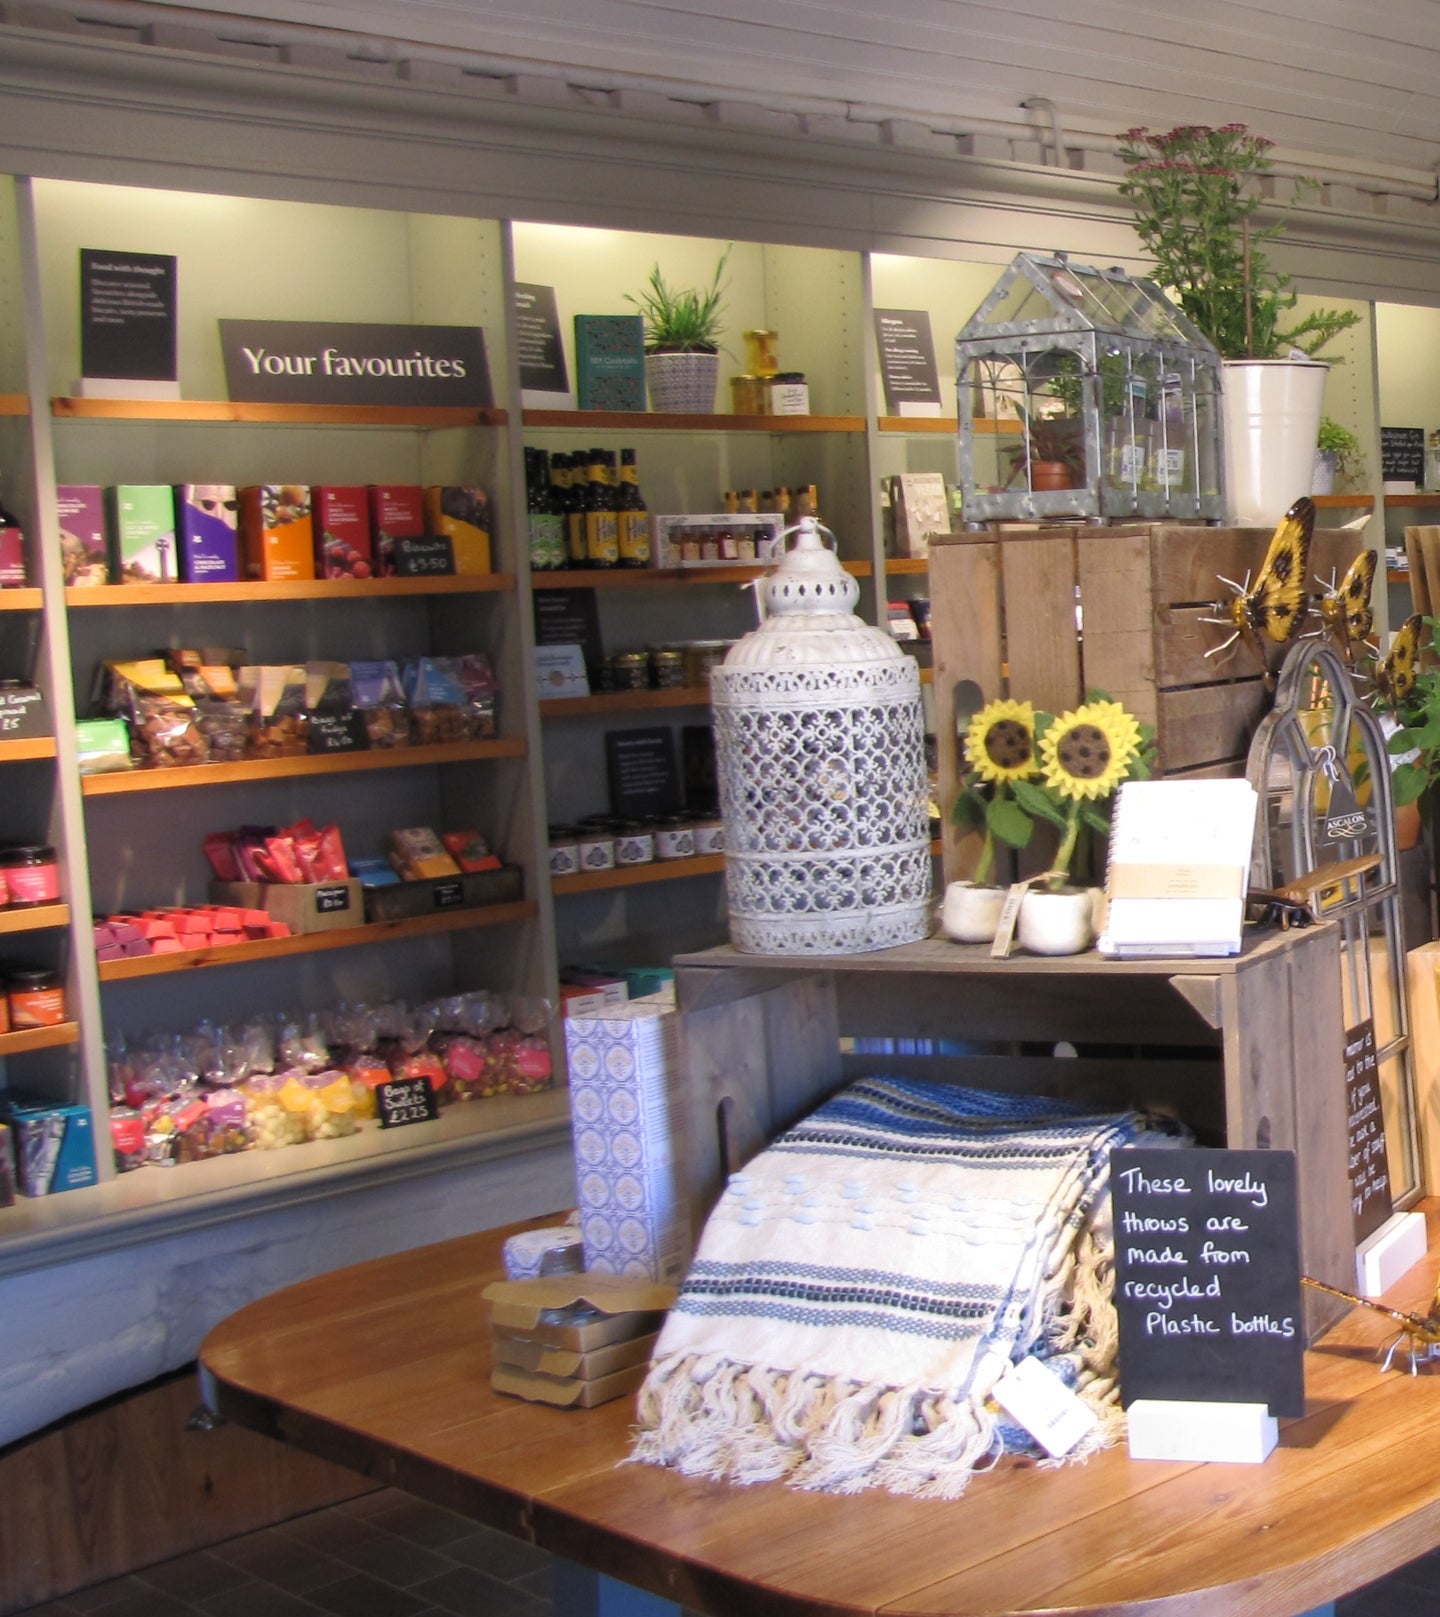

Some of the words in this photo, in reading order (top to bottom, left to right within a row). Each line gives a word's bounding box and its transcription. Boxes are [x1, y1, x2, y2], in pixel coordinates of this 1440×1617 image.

[242, 347, 317, 375] Your
[322, 348, 467, 378] favourites
[1327, 815, 1365, 830] ASCALON
[384, 1085, 410, 1100] Bags
[412, 1080, 425, 1092] of
[385, 1094, 427, 1109] Sweets
[1120, 1167, 1192, 1194] These
[1208, 1169, 1268, 1206] lovely
[1122, 1211, 1190, 1233] throws
[1206, 1216, 1249, 1231] are
[1128, 1246, 1188, 1264] made
[1200, 1241, 1250, 1263] from
[1124, 1275, 1222, 1309] recycled
[1146, 1312, 1221, 1335] Plastic
[1231, 1312, 1296, 1337] bottles
